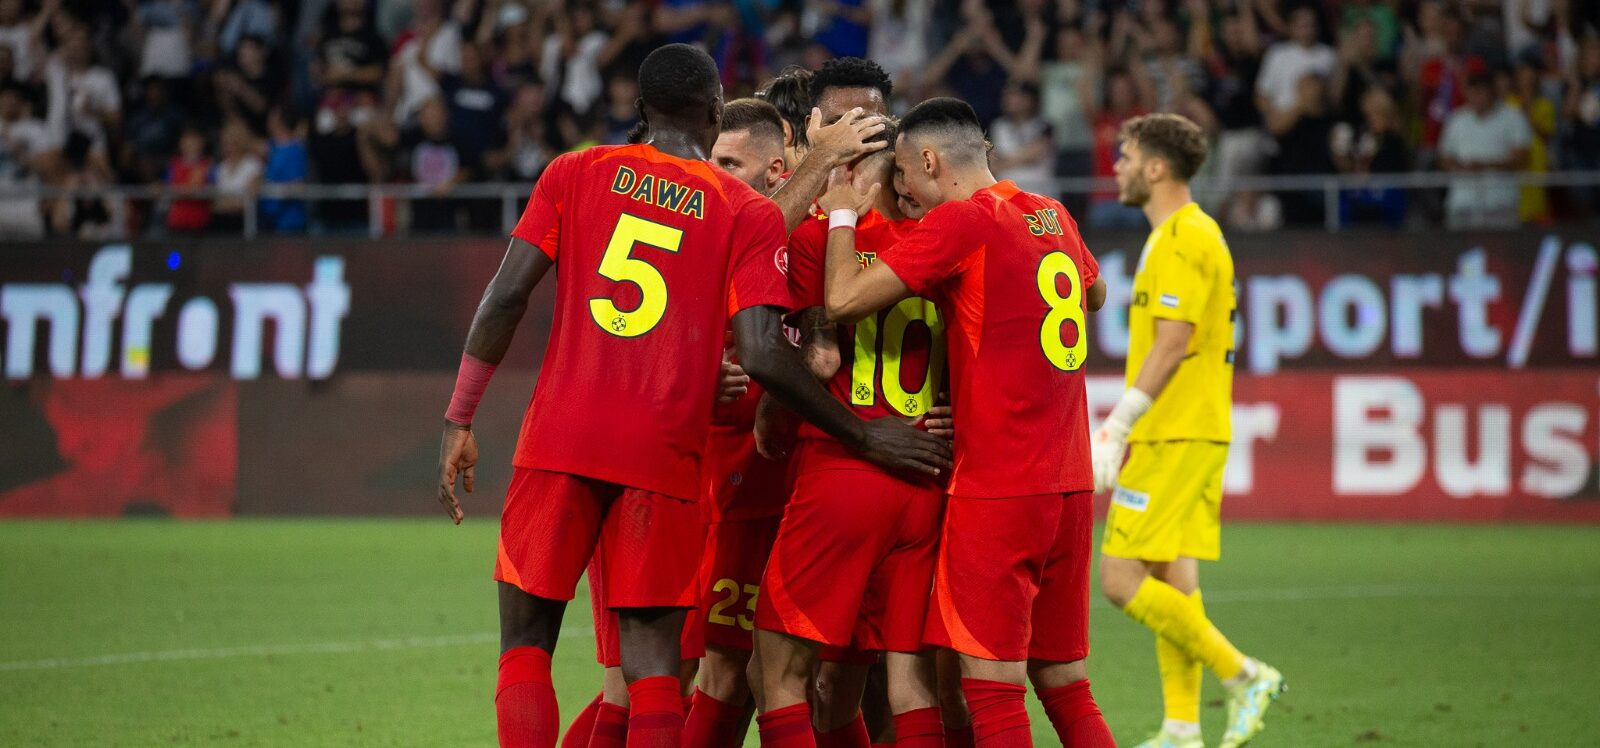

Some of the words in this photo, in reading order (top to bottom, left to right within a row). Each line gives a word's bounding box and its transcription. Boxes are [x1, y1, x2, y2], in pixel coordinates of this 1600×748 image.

[611, 165, 705, 220] DAWA
[588, 212, 685, 338] 5
[1036, 250, 1088, 372] 8
[850, 296, 945, 417] 10
[1333, 375, 1591, 499] Bus
[708, 578, 760, 631] 23
